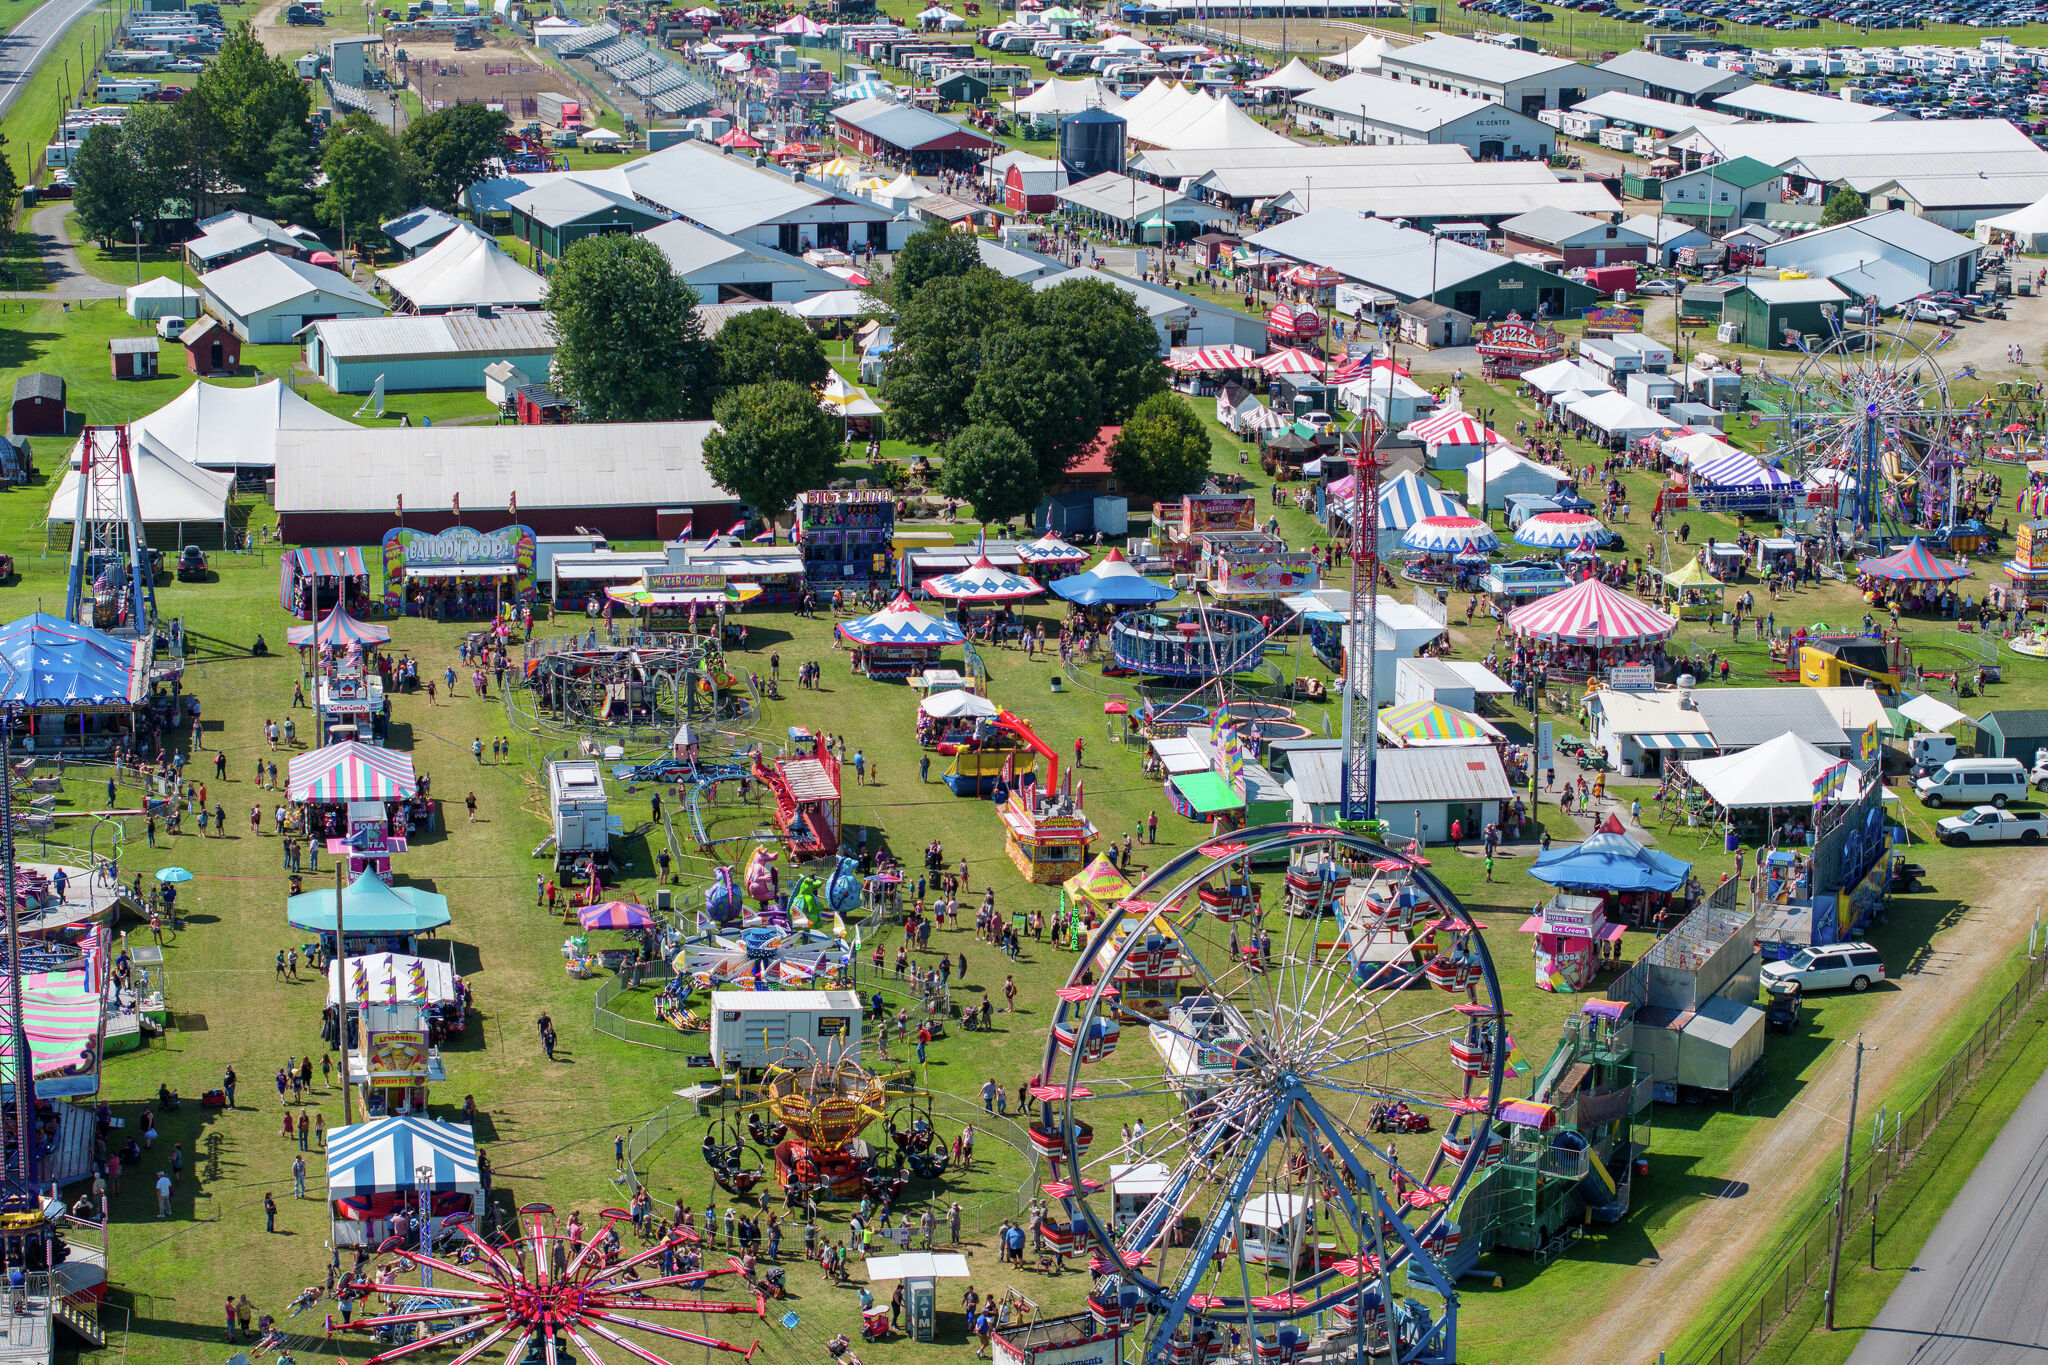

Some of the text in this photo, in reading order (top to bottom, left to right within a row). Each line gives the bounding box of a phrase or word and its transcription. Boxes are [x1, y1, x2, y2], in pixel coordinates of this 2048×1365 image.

[1492, 326, 1537, 348] PIZZA
[807, 489, 893, 503] BIG PRIZES
[409, 539, 510, 560] BALLOON POP!
[1230, 563, 1312, 576] CANDY LAND
[652, 575, 681, 586] WATER
[684, 574, 701, 586] GUN
[354, 822, 380, 831] BOBA
[1547, 914, 1568, 923] BUBBLE
[1564, 926, 1586, 934] Cream
[1558, 953, 1580, 961] BOBA
[918, 1296, 931, 1328] ATM
